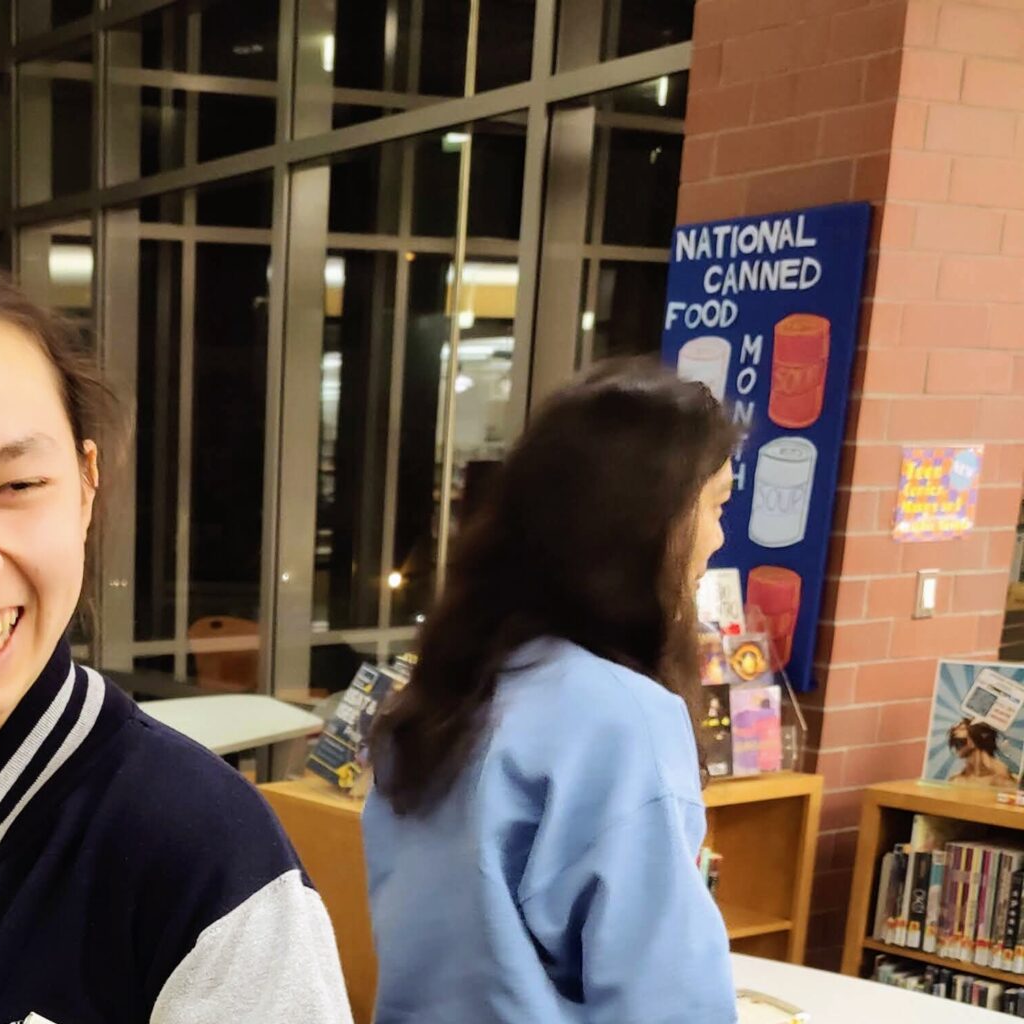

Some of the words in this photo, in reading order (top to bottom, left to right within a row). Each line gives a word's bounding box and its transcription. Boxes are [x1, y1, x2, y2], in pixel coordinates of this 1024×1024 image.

[676, 215, 817, 262] NATIONAL
[703, 256, 822, 296] CANNED
[664, 299, 738, 330] FOOD
[755, 485, 804, 513] SOUP
